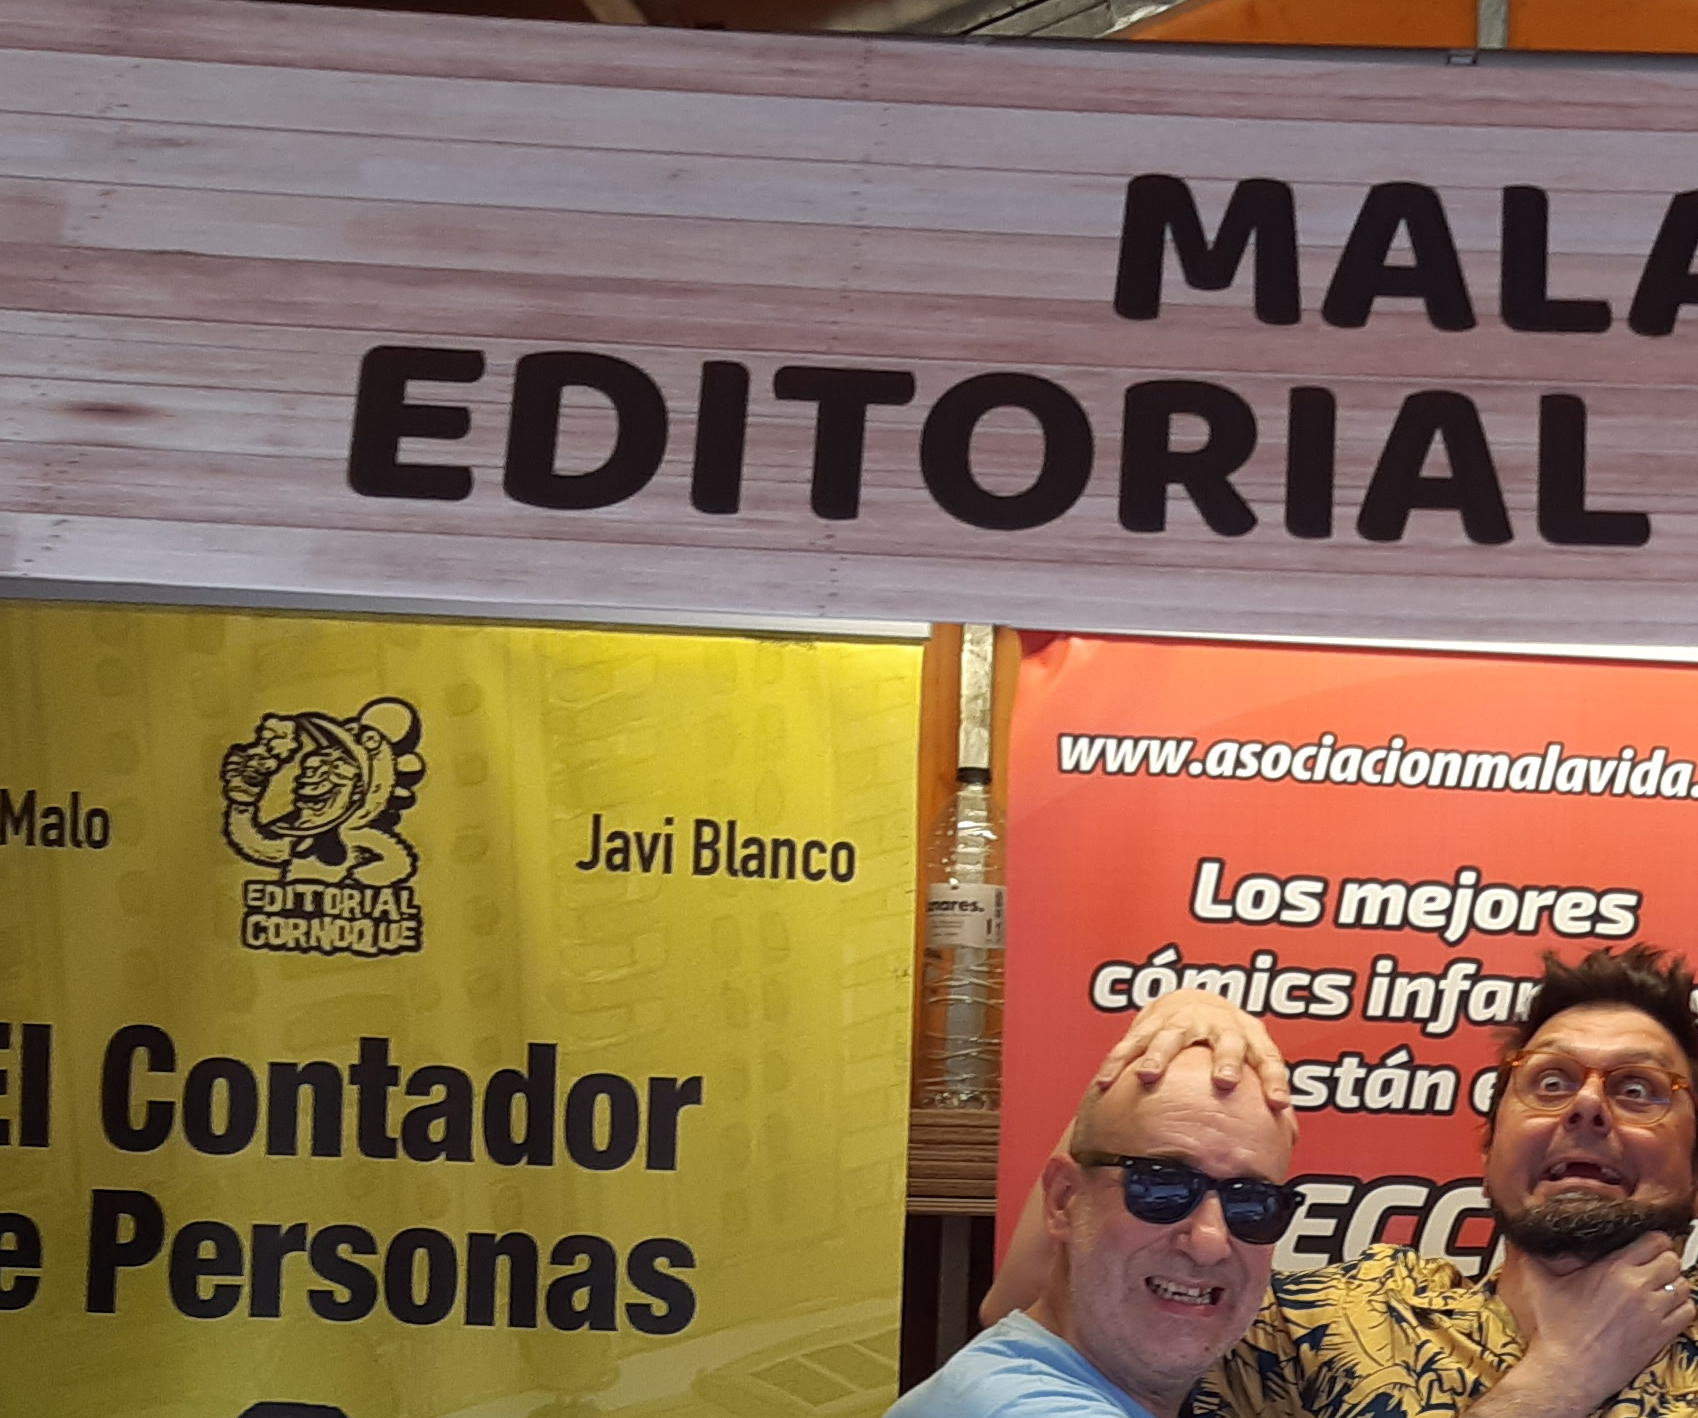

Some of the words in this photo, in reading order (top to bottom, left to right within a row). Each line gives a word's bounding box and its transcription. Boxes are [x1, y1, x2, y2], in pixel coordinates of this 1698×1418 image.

[346, 344, 1652, 547] EDITORIAL
[0, 789, 110, 850] Malo
[576, 813, 674, 876] Javi
[693, 818, 858, 883] Blanco
[242, 914, 424, 956] CORNOQUE
[244, 882, 419, 918] EDITORIAL
[1191, 859, 1323, 924] Los
[1337, 870, 1642, 944] mejores
[100, 1022, 703, 1172] Contador
[86, 1188, 698, 1335] Personas
